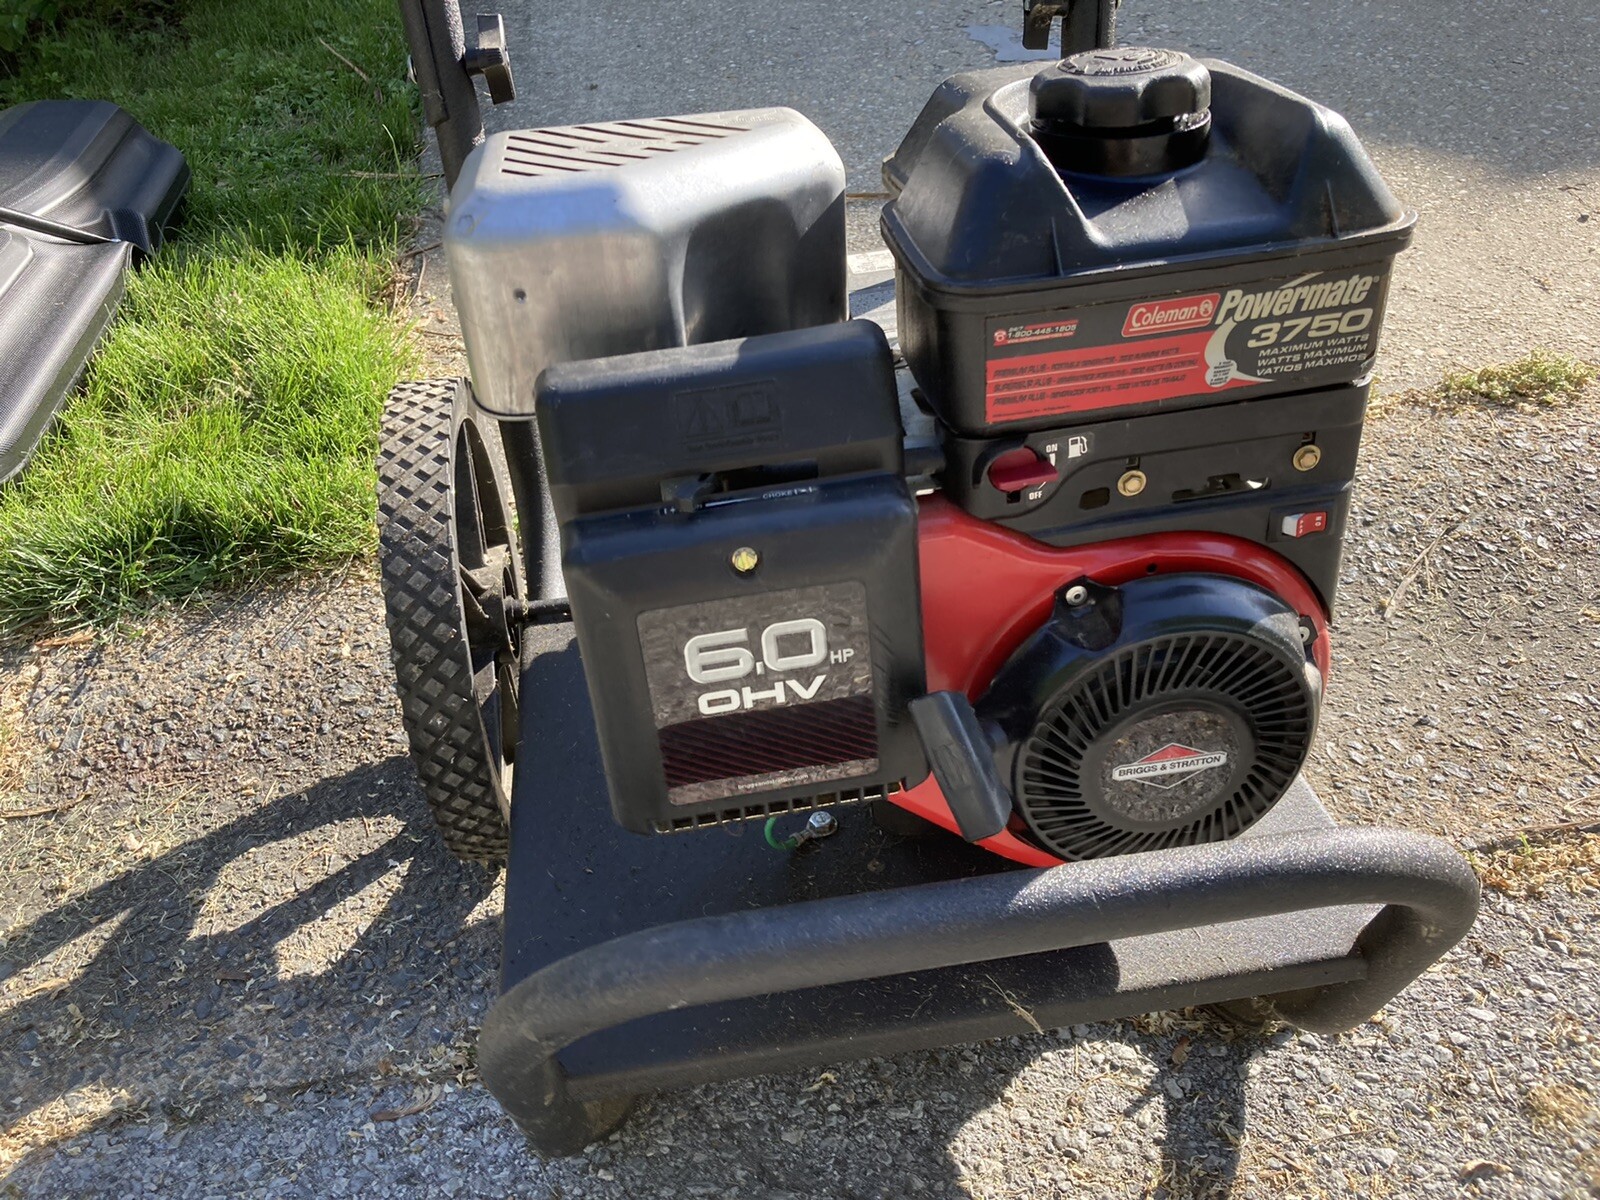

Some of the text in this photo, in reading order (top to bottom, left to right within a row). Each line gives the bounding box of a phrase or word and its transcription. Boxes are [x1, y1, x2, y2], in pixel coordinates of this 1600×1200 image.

[1215, 275, 1374, 325] Powermate
[1131, 305, 1198, 328] Coleman
[1247, 308, 1373, 348] 3750
[1257, 343, 1368, 367] WATTS MAXIMUM
[1258, 333, 1370, 357] MAXIMUM WATTS
[1256, 363, 1302, 376] VATIOS
[1045, 443, 1058, 453] ON
[762, 489, 793, 500] CHOKE
[1028, 491, 1043, 500] OFF
[684, 618, 855, 684] 6.0 HP
[698, 674, 827, 715] OHV
[1118, 755, 1221, 777] BRIGGS & STRATTON
